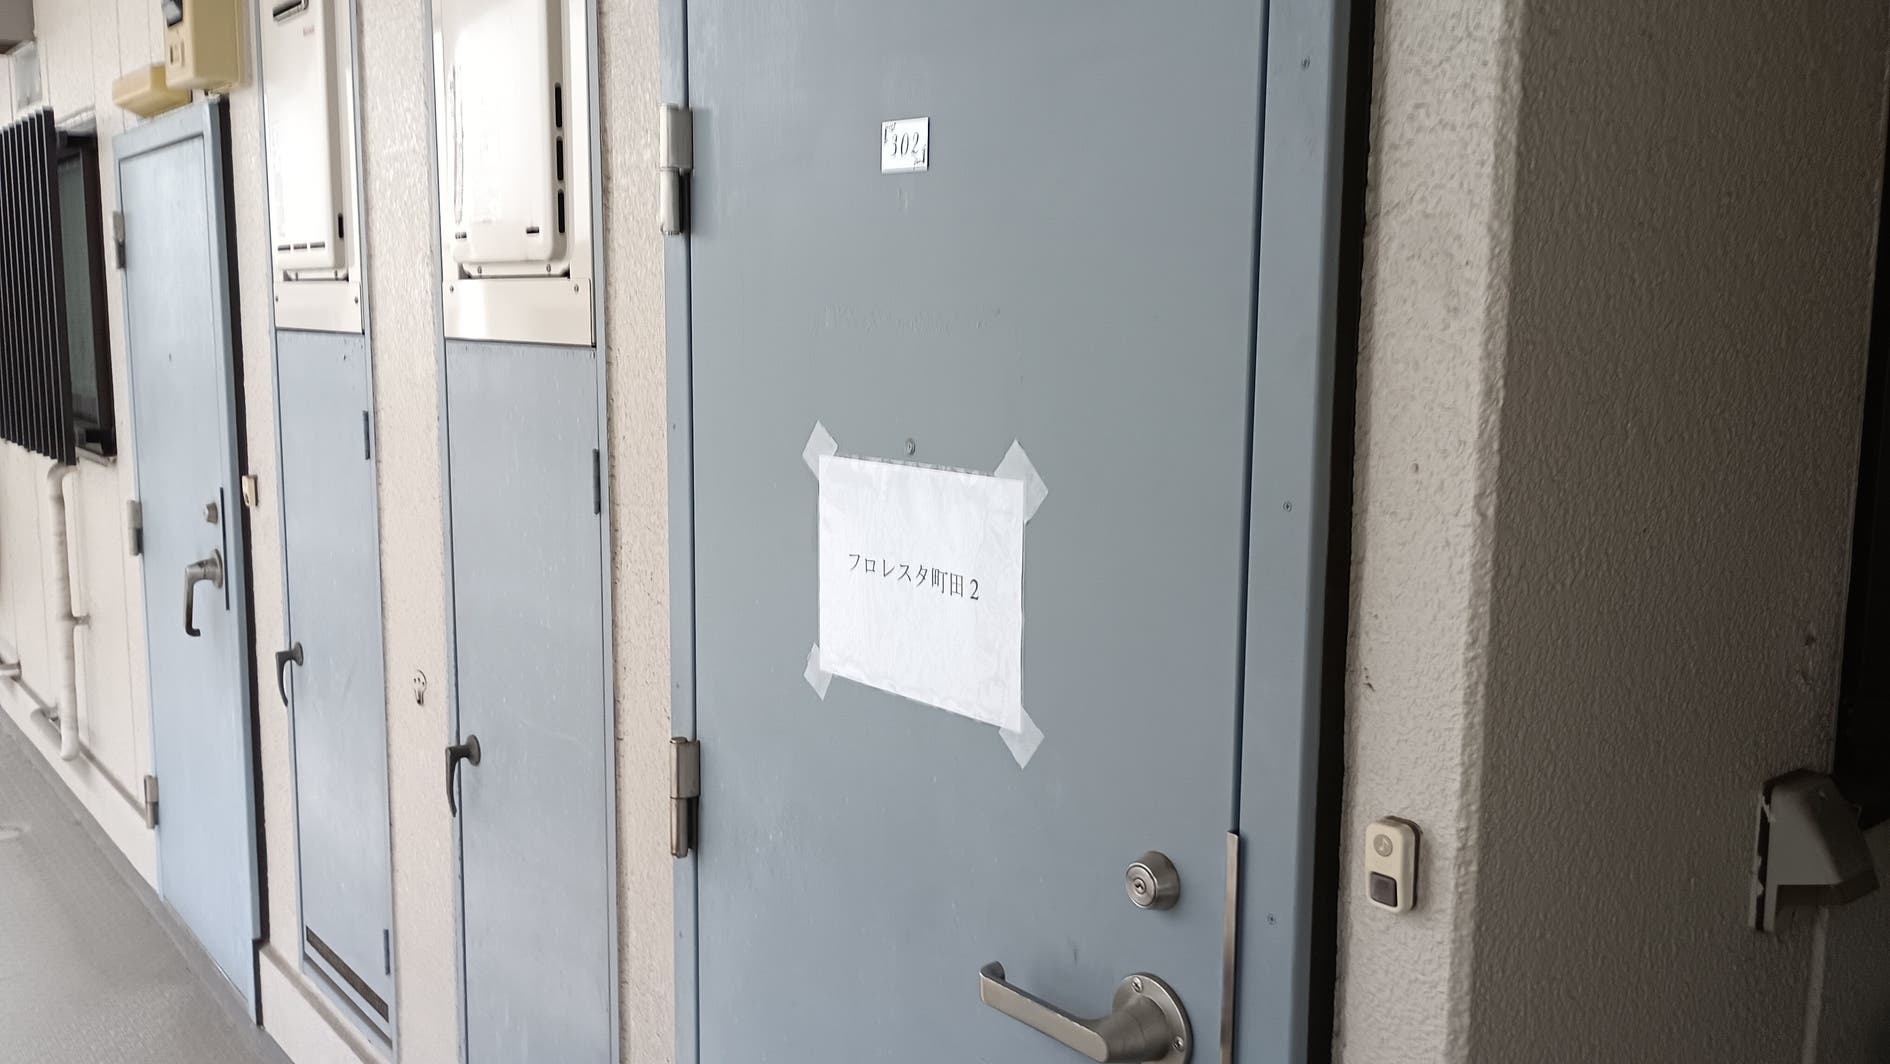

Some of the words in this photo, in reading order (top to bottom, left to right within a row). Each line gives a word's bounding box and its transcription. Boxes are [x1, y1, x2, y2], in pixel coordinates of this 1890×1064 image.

[890, 131, 920, 158] 302
[848, 552, 980, 601] フロレスタ町田2
